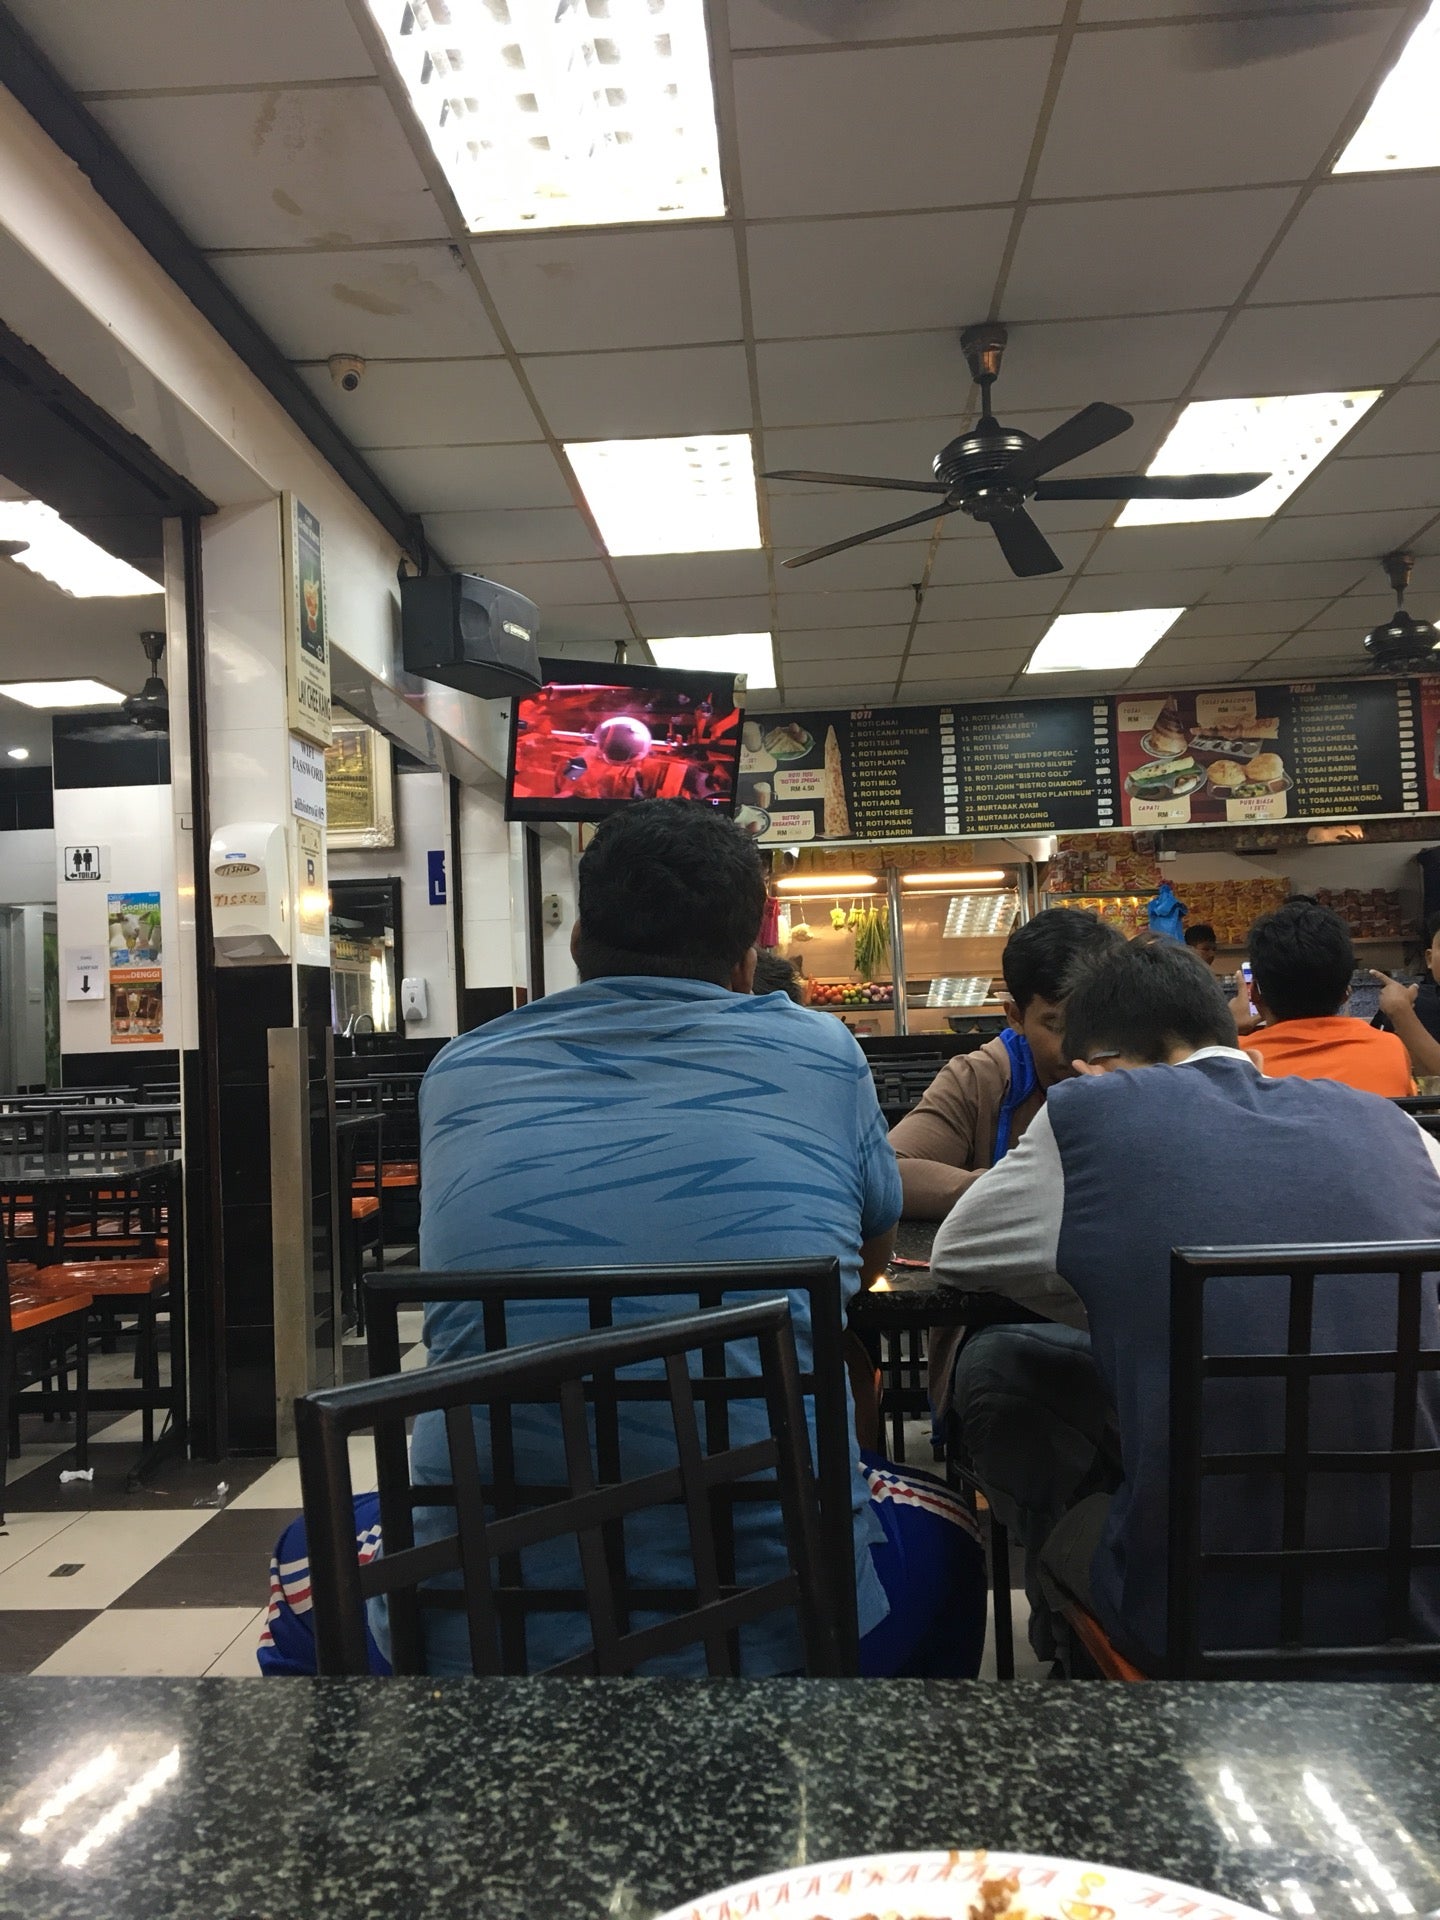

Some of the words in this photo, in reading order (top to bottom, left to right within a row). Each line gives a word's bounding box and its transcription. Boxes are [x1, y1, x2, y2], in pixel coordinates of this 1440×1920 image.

[1289, 685, 1316, 693] TOSAI
[851, 711, 872, 719] ROTI
[300, 742, 314, 760] WIFI
[292, 756, 324, 782] PASSWORD
[130, 970, 160, 980] DENGGI
